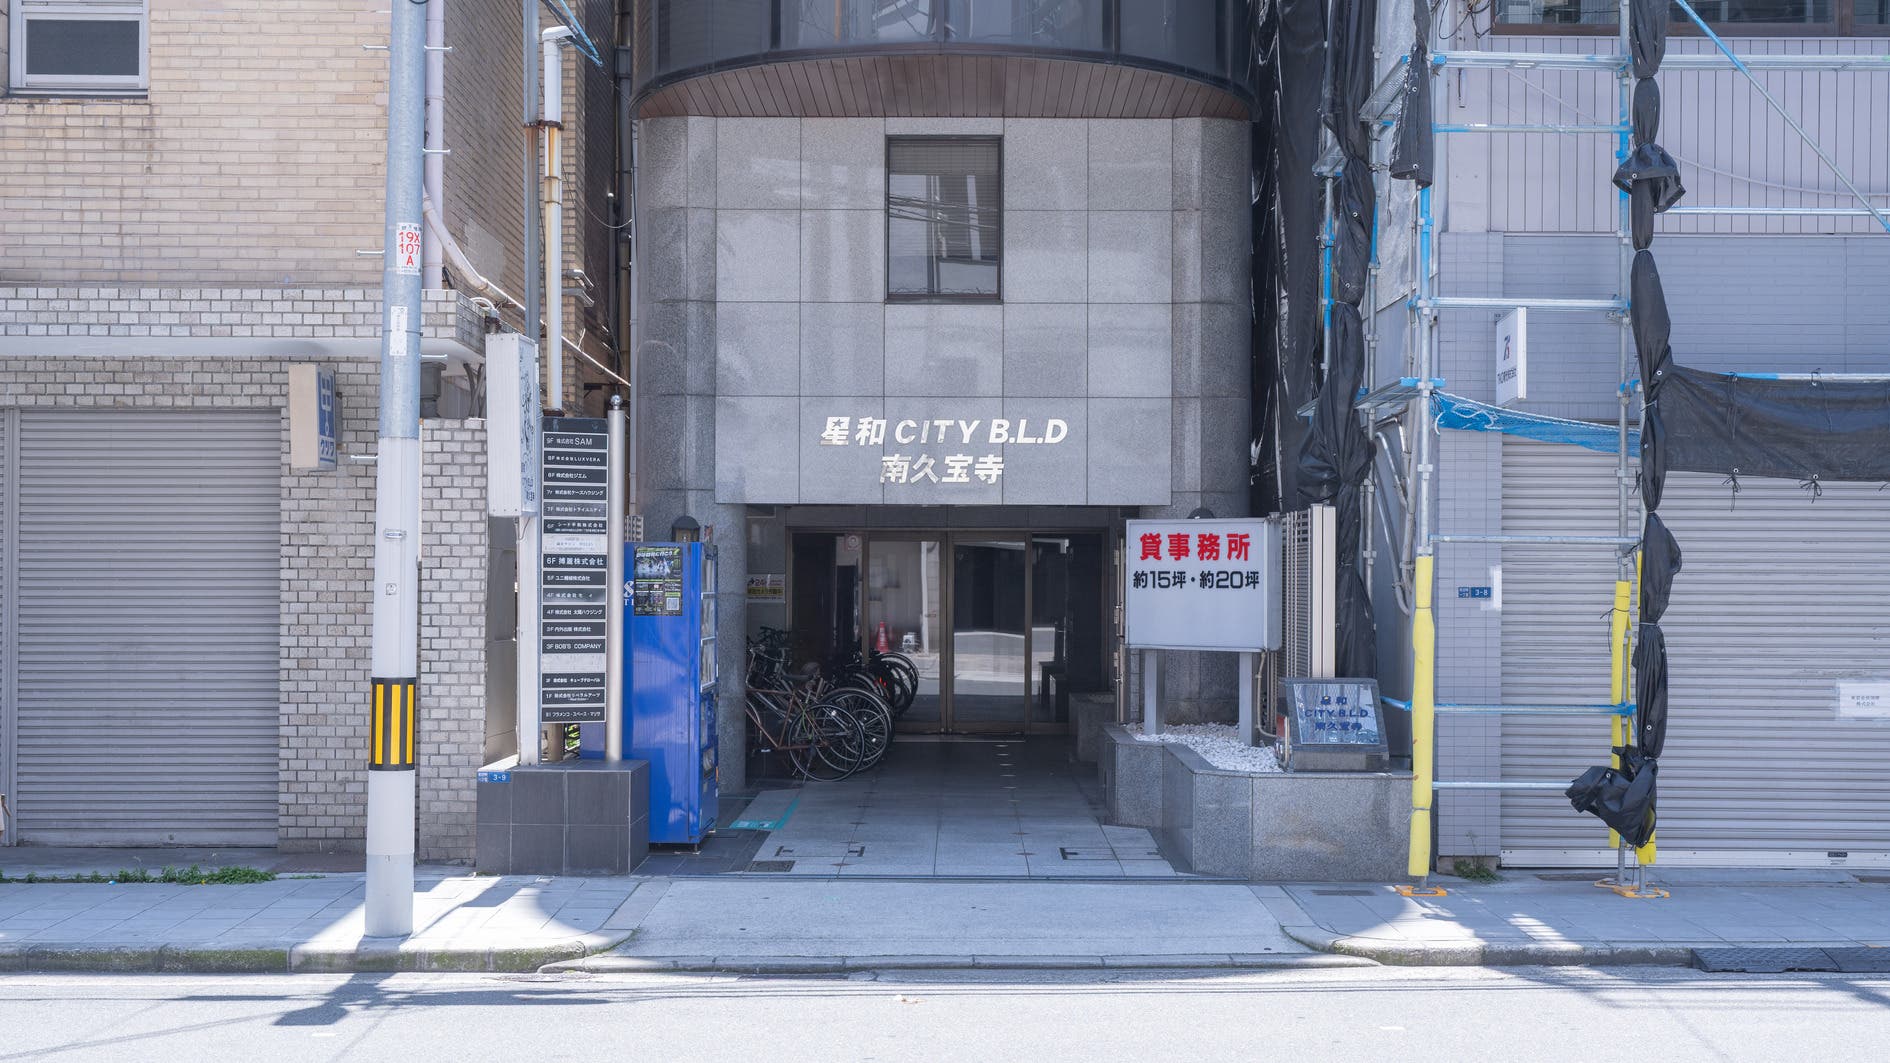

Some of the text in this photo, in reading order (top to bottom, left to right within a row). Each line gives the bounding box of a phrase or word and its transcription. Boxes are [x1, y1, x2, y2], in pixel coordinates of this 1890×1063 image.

[398, 244, 420, 255] 107
[406, 255, 414, 266] A
[820, 416, 1068, 445] 星和 CITY B.L.D
[574, 437, 592, 446] SAM
[880, 454, 1004, 484] 南久宝寺
[1140, 533, 1251, 561] 貸事務所
[1133, 570, 1260, 589] 約15坪・約20坪
